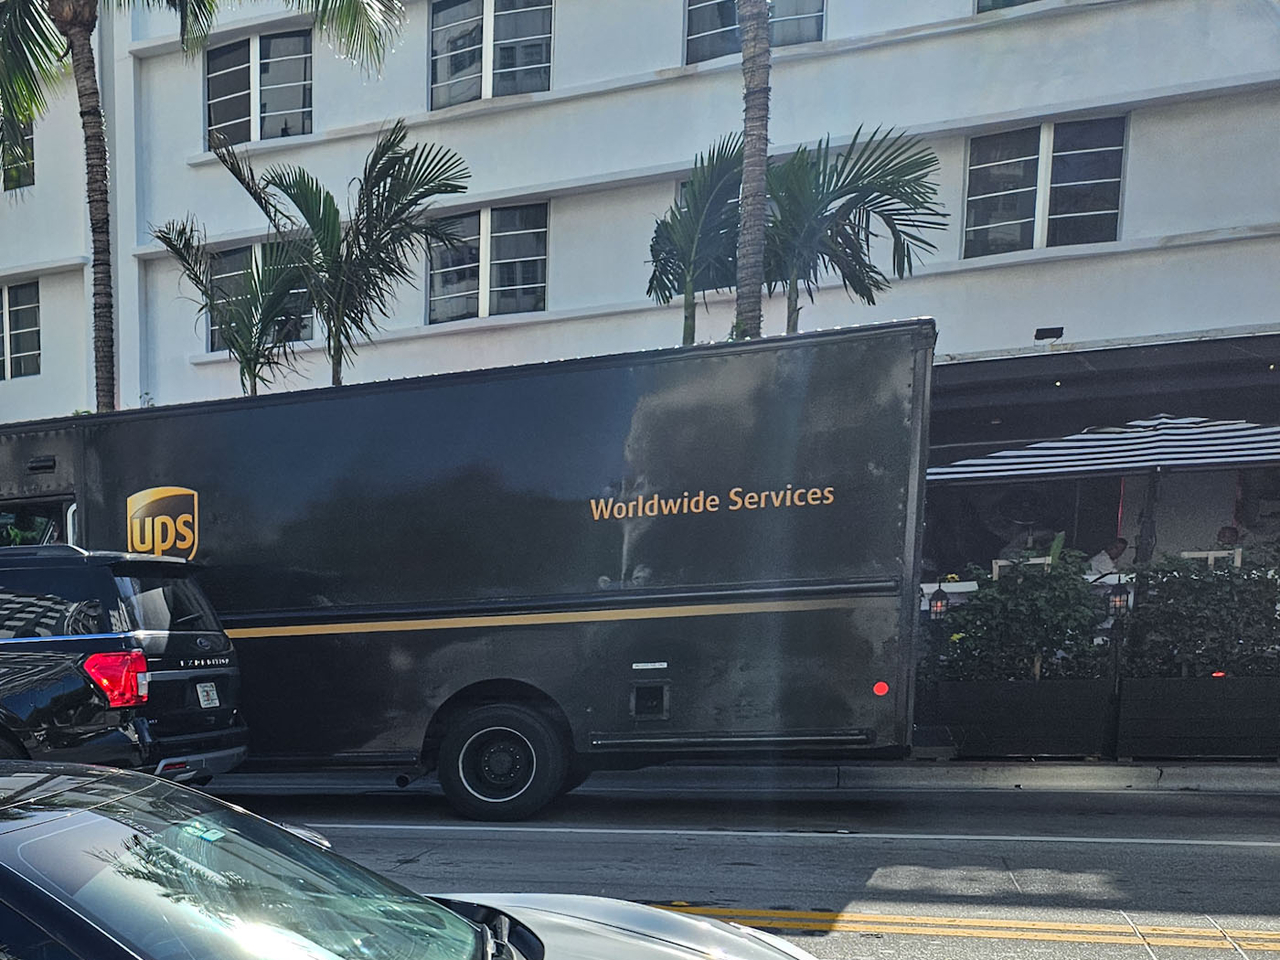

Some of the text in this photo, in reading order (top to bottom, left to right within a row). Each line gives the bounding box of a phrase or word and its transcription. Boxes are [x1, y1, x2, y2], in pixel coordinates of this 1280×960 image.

[590, 483, 834, 521] Worldwide Services
[132, 513, 194, 556] ups
